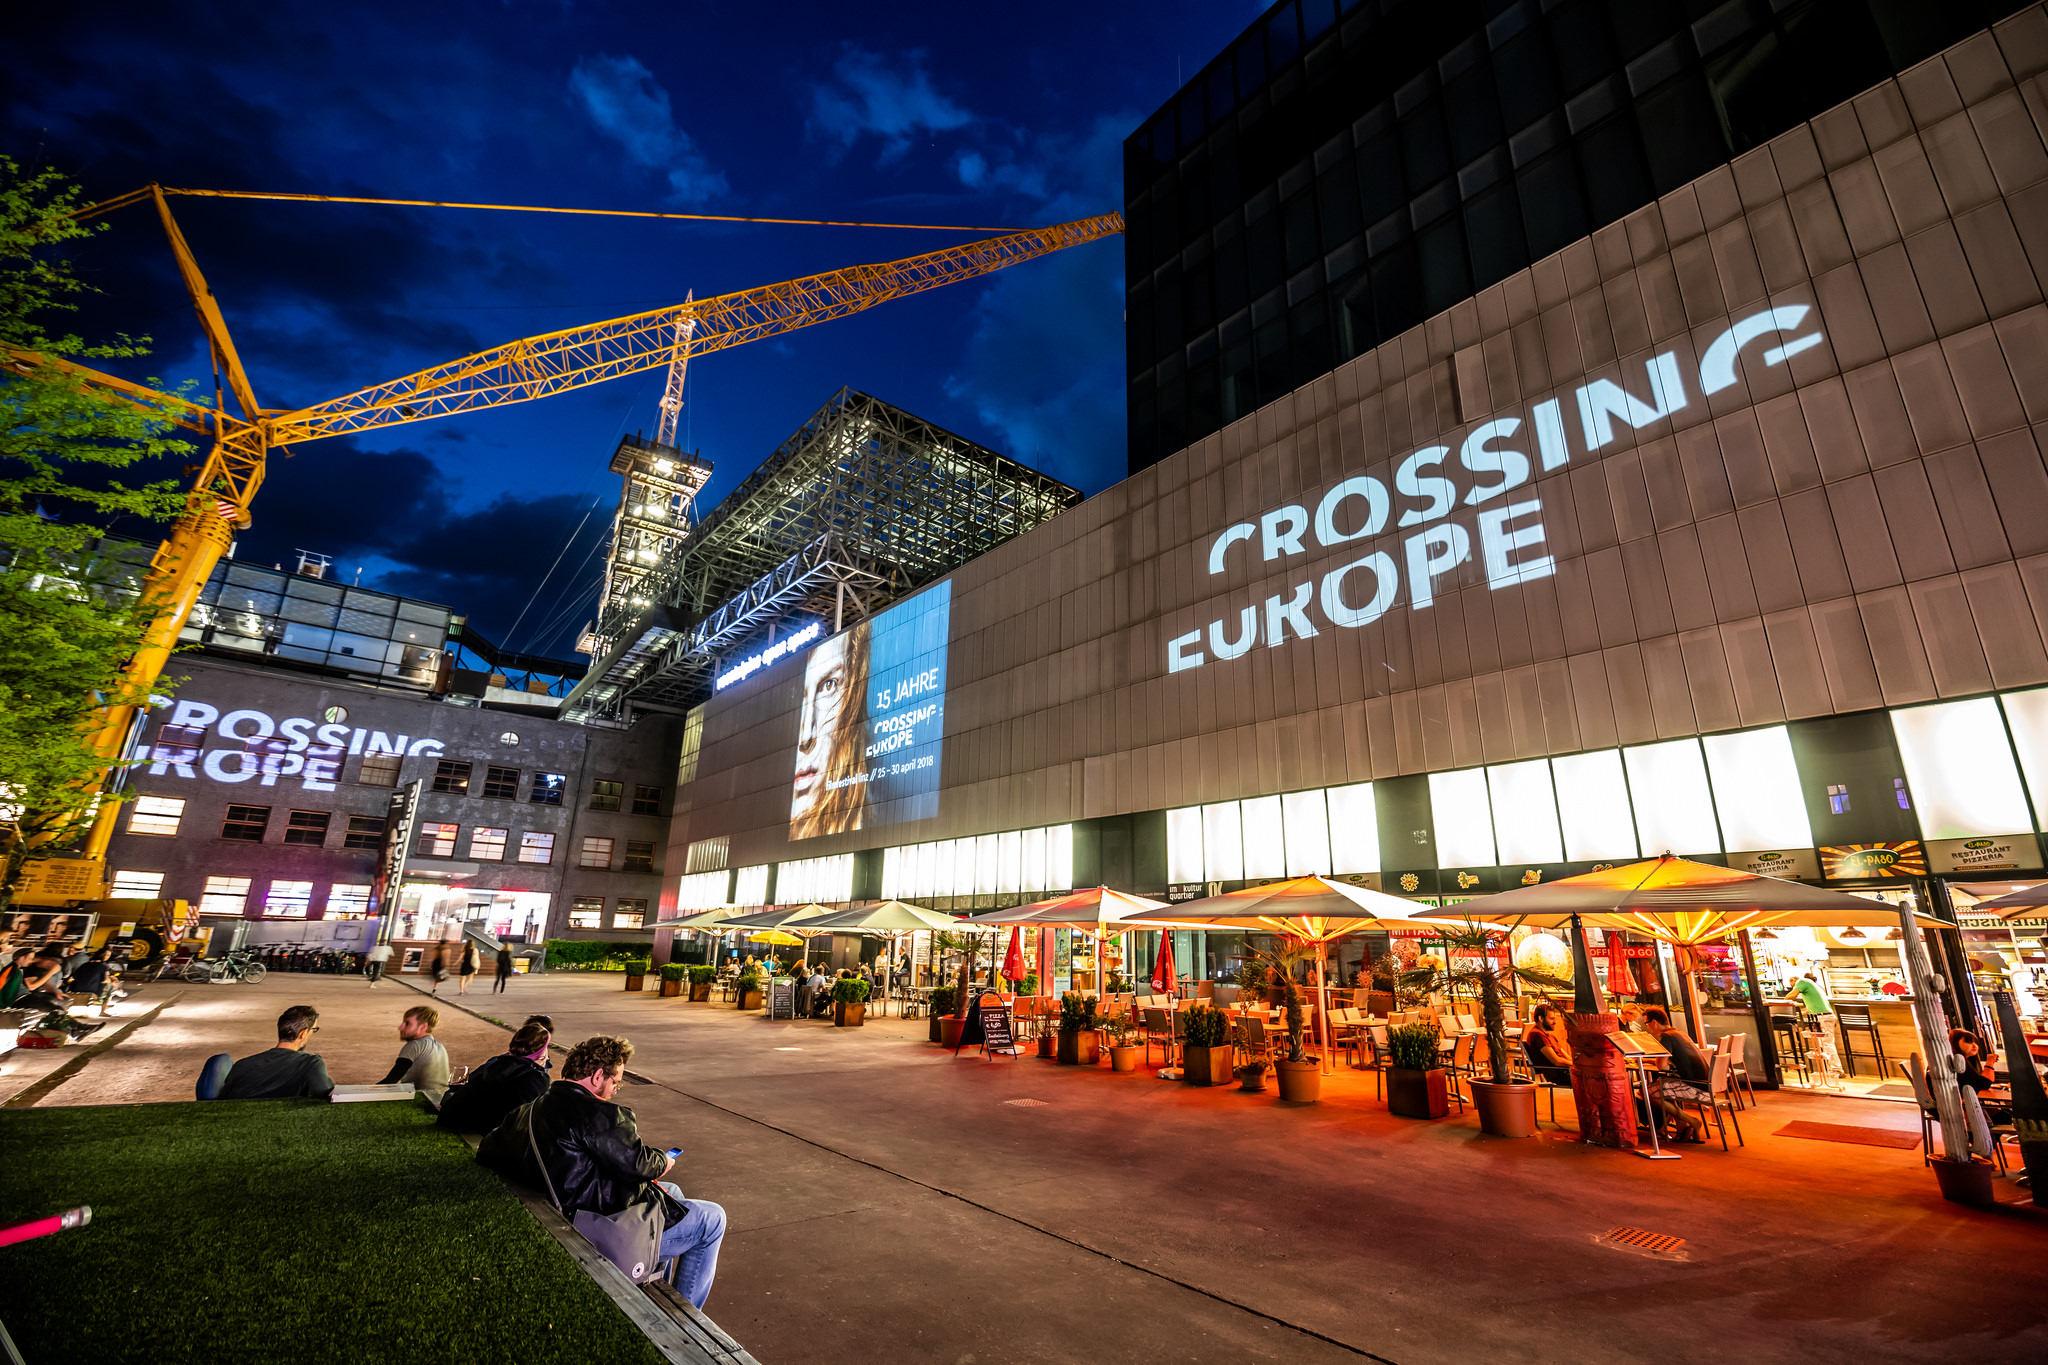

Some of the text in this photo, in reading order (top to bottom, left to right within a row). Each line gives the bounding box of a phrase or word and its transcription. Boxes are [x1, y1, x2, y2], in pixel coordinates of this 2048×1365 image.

[1209, 304, 1824, 574] CROSSING
[1168, 498, 1557, 674] EUROPE
[876, 667, 939, 709] 15 JAHRE
[874, 704, 937, 734] CROSSING
[865, 729, 914, 757] EUROPE
[877, 766, 886, 779] 25
[891, 763, 900, 775] 30
[900, 759, 917, 774] april
[917, 755, 934, 769] 2018
[1950, 845, 2011, 859] RESTAURANT
[1962, 852, 2004, 864] PIZZERIA
[1747, 858, 1796, 870] RESTAURANT
[1756, 864, 1790, 874] PIZZERIA
[1169, 892, 1195, 901] quartier
[1622, 948, 1636, 957] TO
